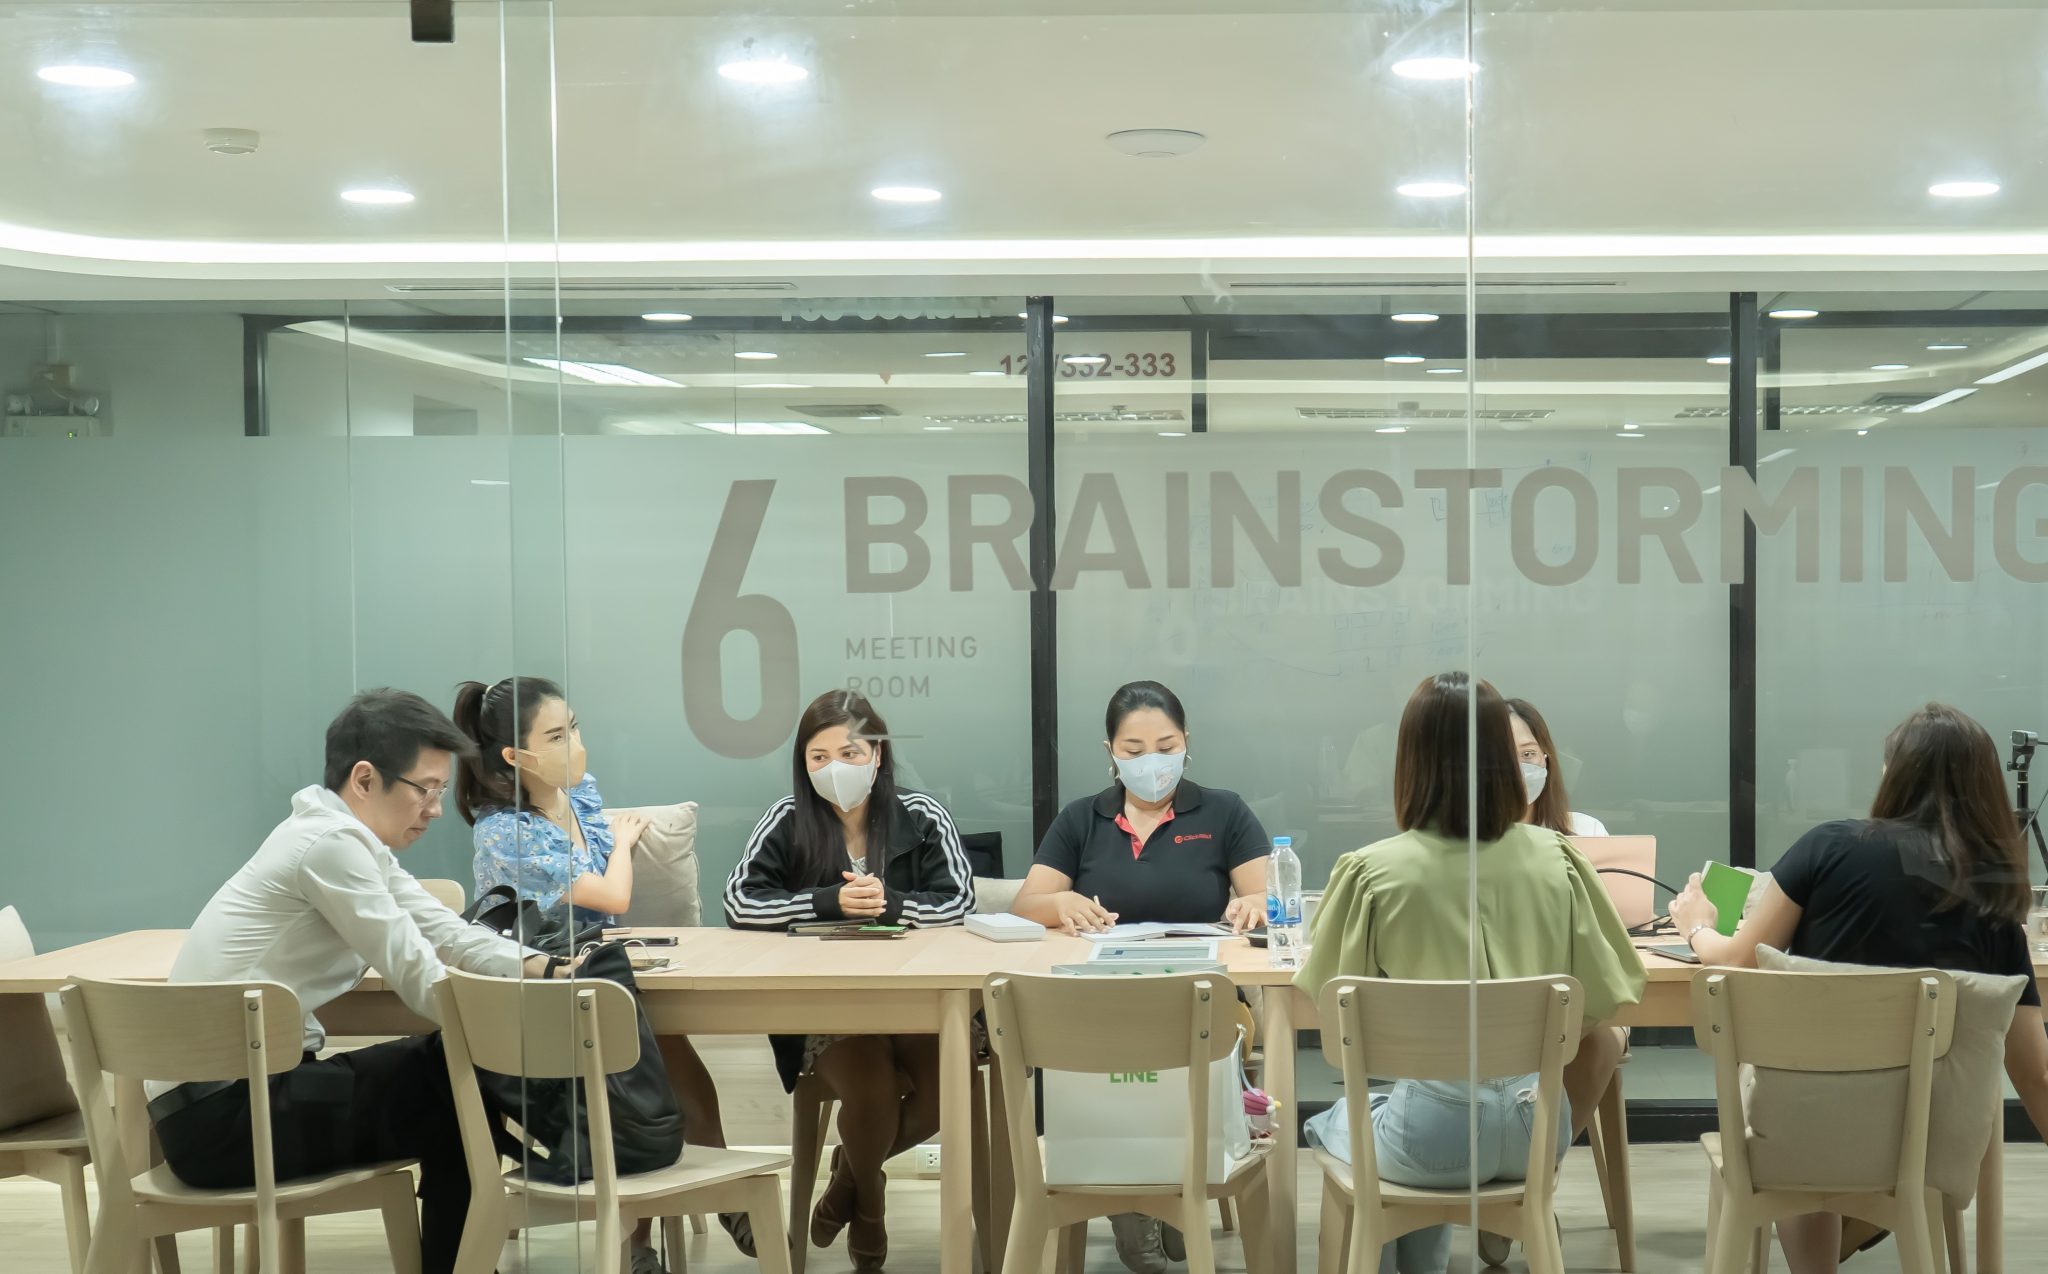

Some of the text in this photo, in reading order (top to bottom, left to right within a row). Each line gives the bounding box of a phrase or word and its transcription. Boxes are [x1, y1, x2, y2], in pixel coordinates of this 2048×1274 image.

[843, 466, 2048, 594] BRAINSTORMING
[681, 479, 800, 760] 6
[845, 636, 978, 660] MEETING
[847, 675, 931, 699] ROOM
